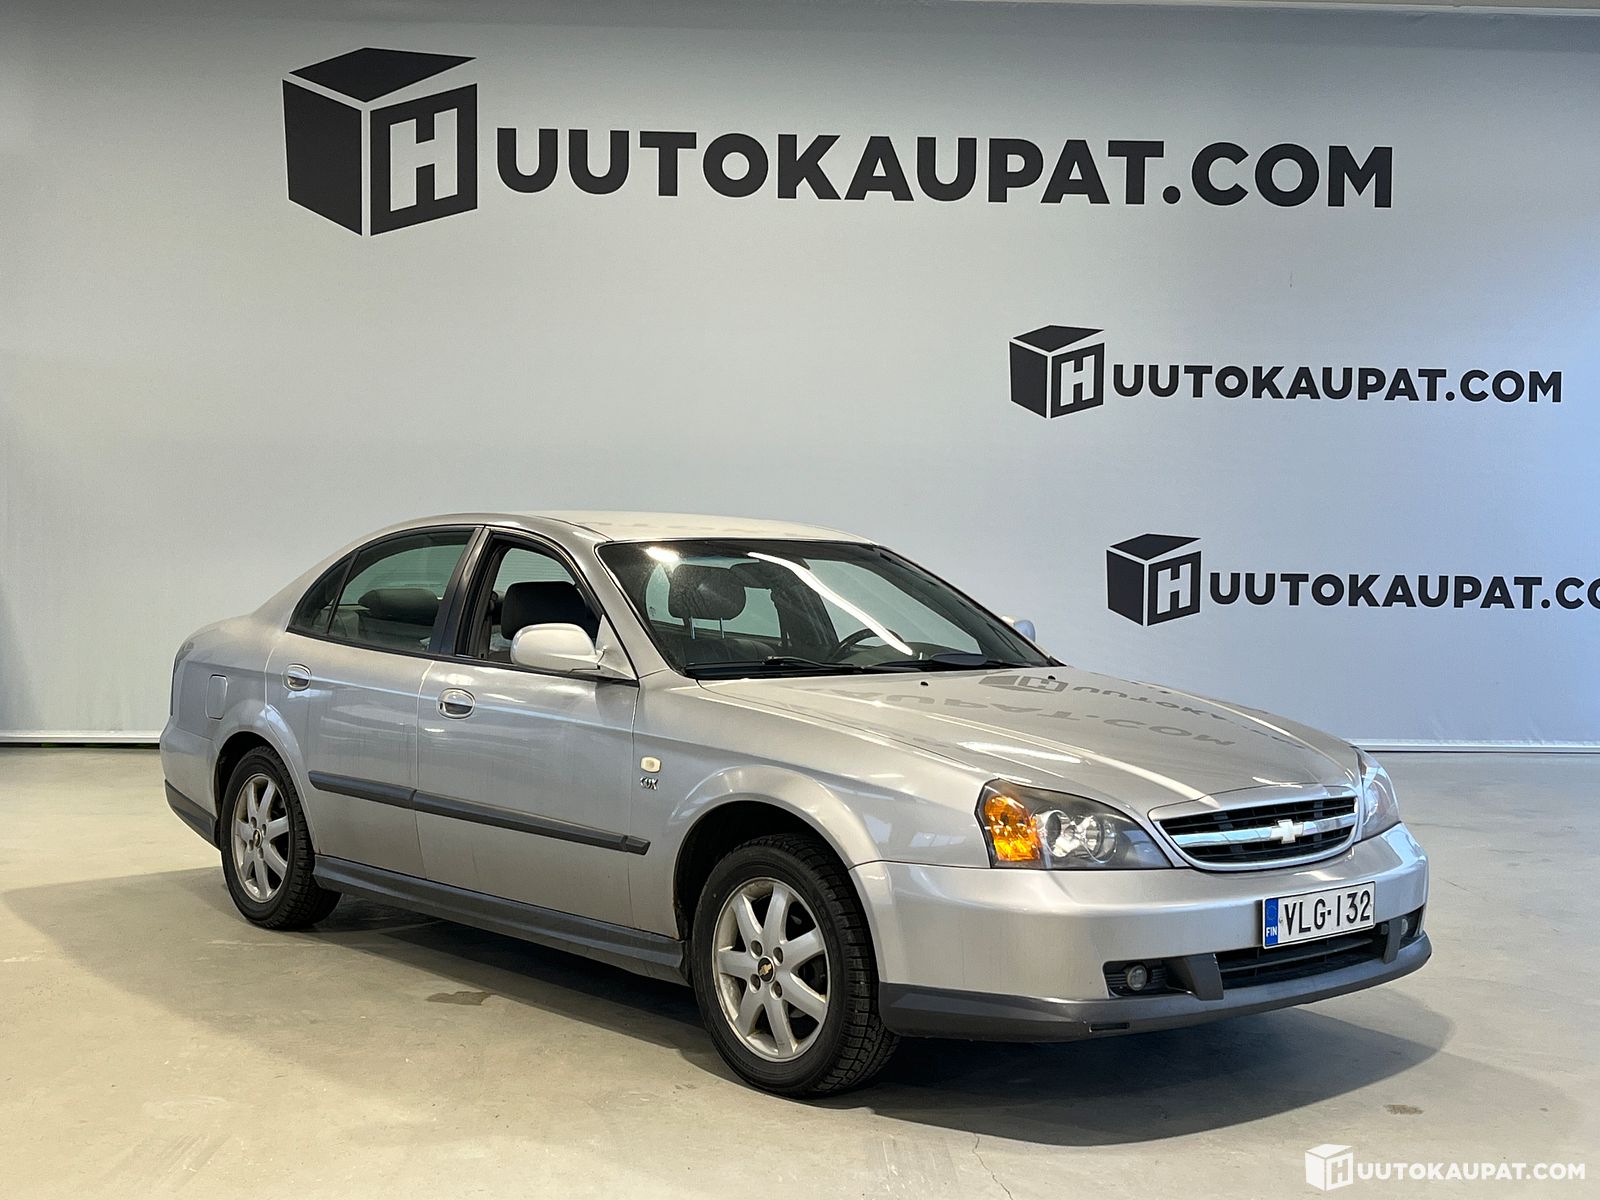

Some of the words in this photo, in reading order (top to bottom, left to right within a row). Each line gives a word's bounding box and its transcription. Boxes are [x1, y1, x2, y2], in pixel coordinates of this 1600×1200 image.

[389, 107, 1393, 212] HUUTOKAUPAT.COM
[1060, 354, 1562, 406] HUUTOKAUPAT.COM
[1265, 926, 1278, 937] FIN
[1284, 890, 1371, 936] VLG-132
